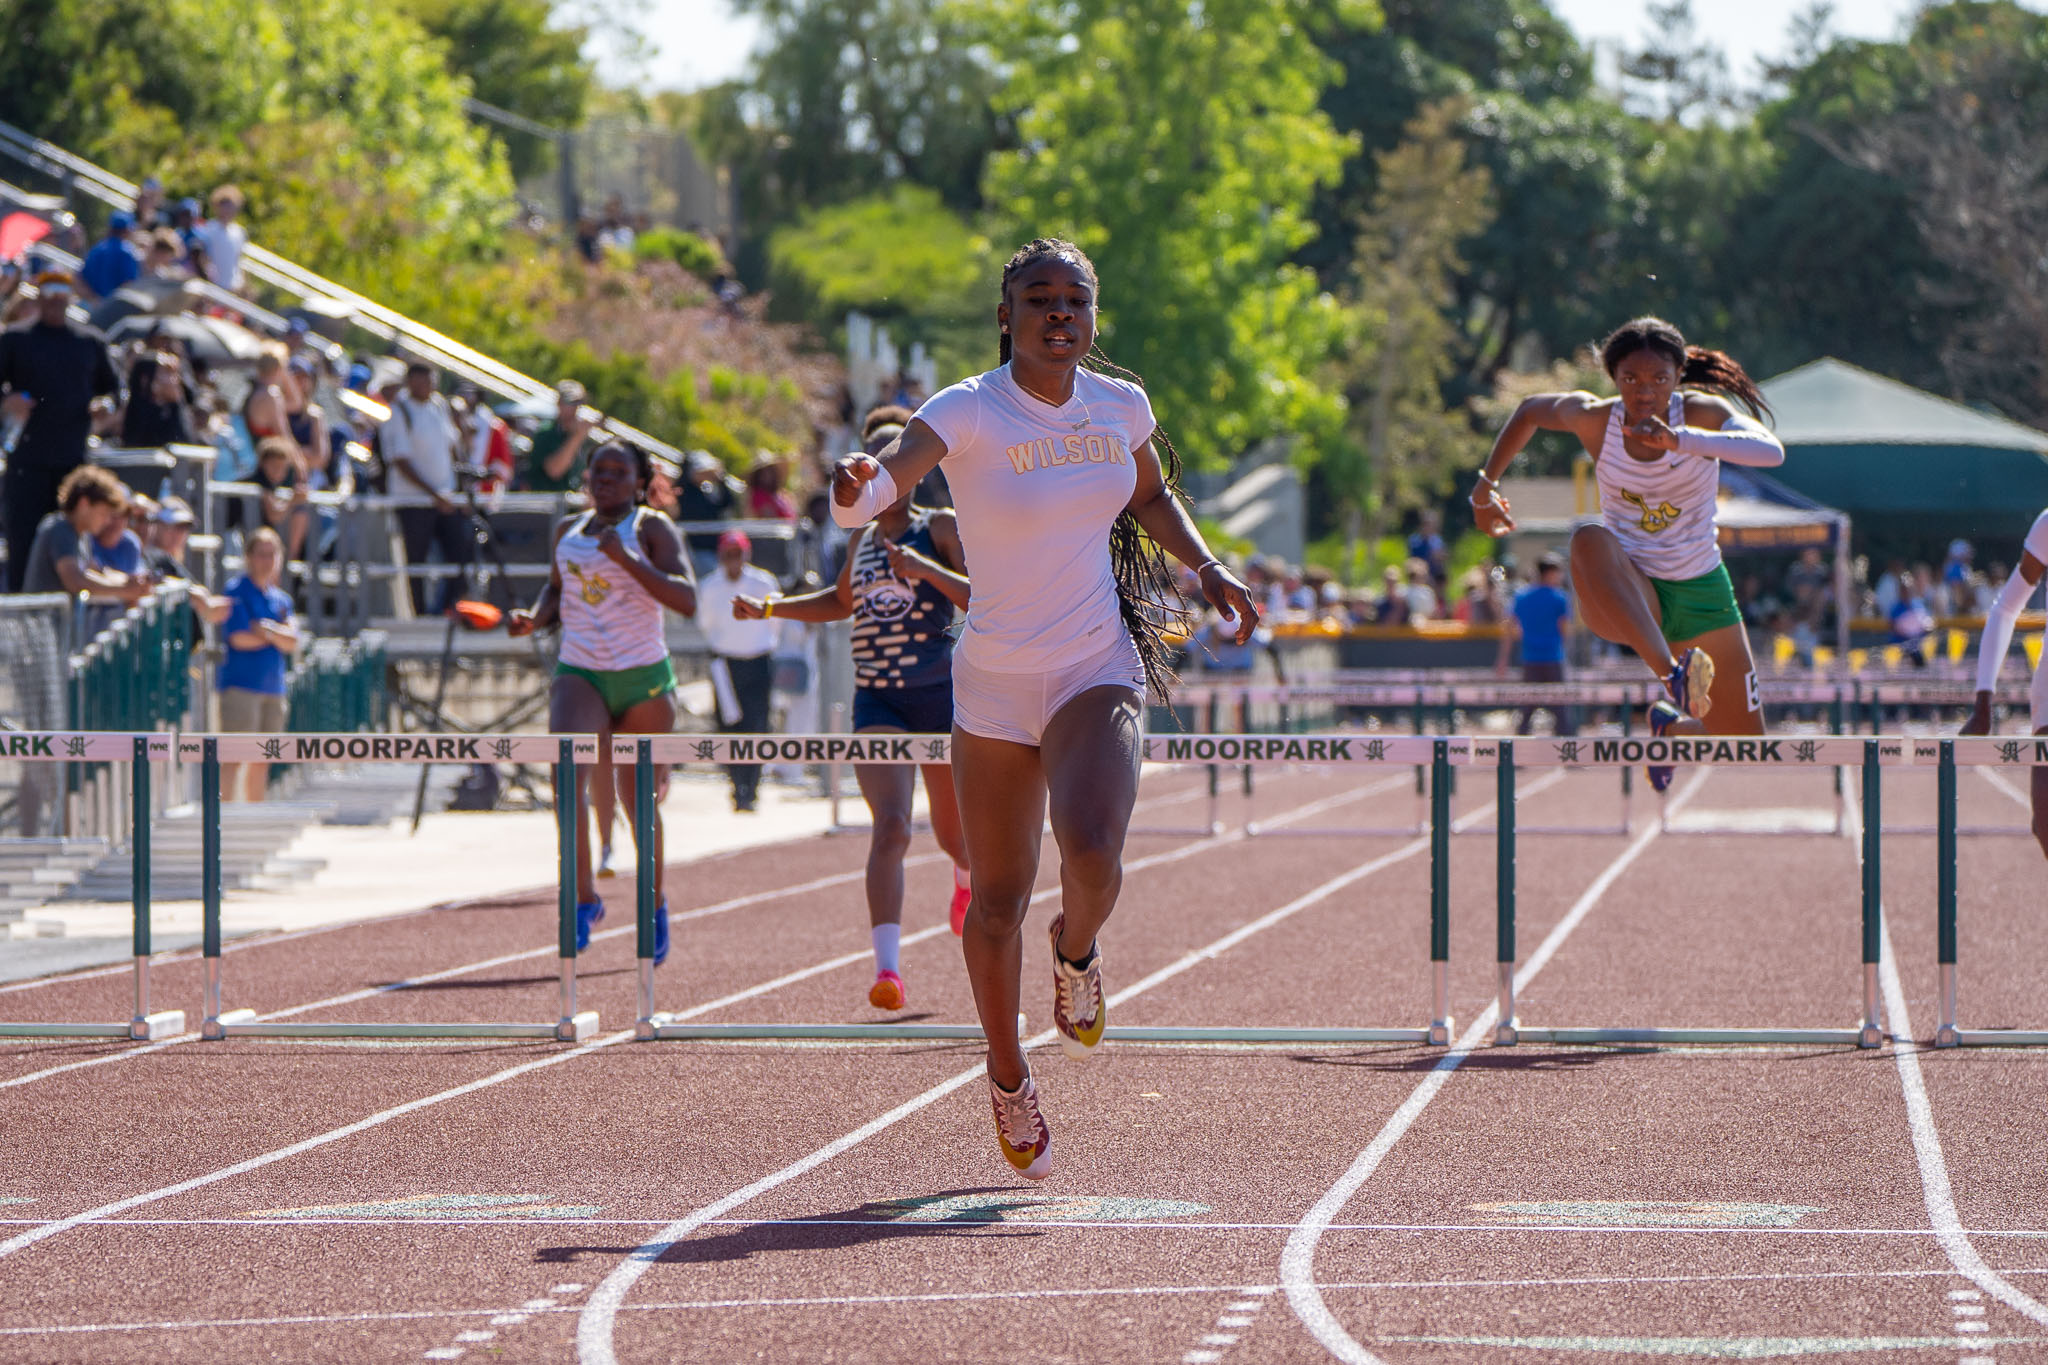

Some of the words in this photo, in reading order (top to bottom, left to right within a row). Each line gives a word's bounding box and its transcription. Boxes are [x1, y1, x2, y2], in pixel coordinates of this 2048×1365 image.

[1006, 434, 1127, 475] WILSON
[296, 738, 481, 759] MOORPARK
[727, 740, 915, 762] MOORPARK
[1166, 740, 1352, 761] MOORPARK
[1593, 740, 1782, 762] MOORPARK
